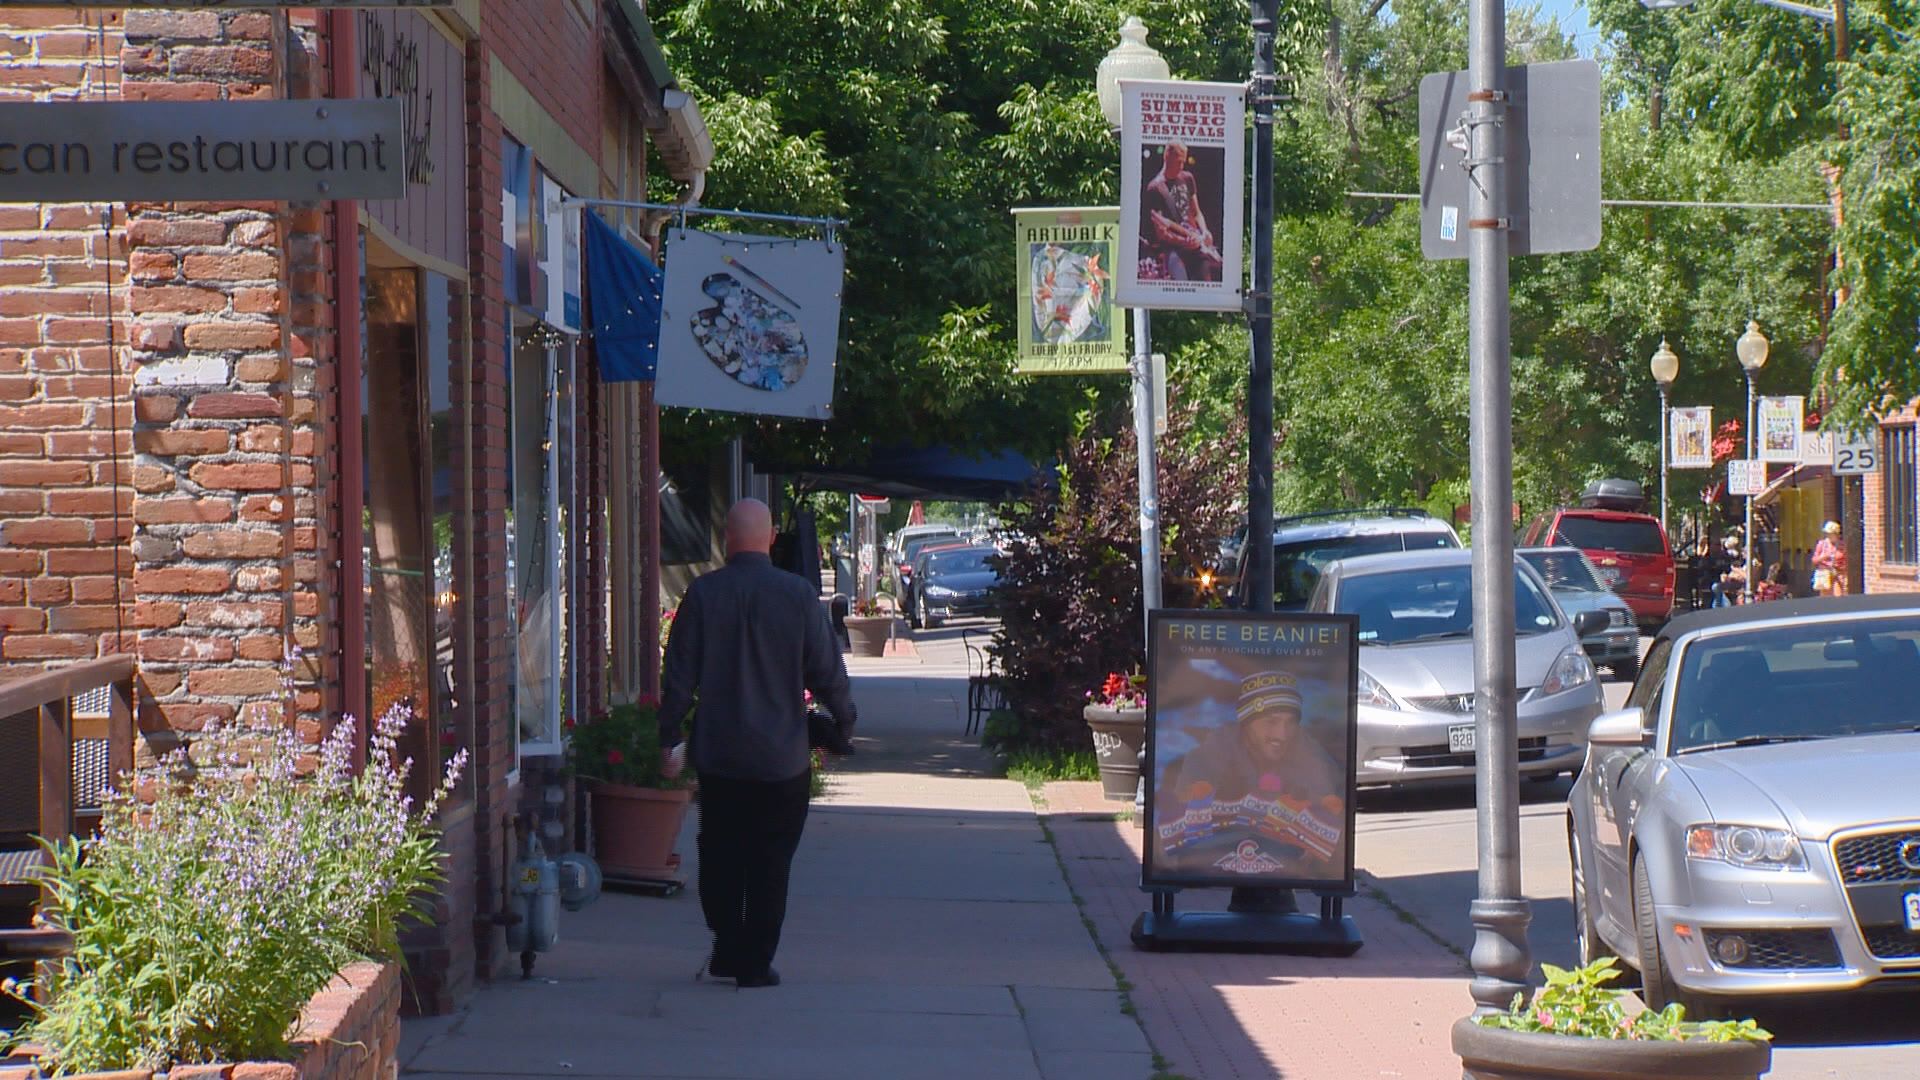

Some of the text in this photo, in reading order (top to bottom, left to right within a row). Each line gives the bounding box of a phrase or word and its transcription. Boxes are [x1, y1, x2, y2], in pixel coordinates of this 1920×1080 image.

[1141, 99, 1226, 115] SUMMER
[1141, 113, 1226, 126] MUSIC
[1142, 124, 1225, 138] FESTIVALS
[112, 132, 388, 174] restaurant
[1027, 225, 1114, 242] ARTWALK
[1032, 345, 1058, 356] EVERY
[1079, 343, 1112, 355] FRIDAY
[1837, 449, 1874, 470] 25
[1168, 624, 1339, 644] FREE BEANIE!
